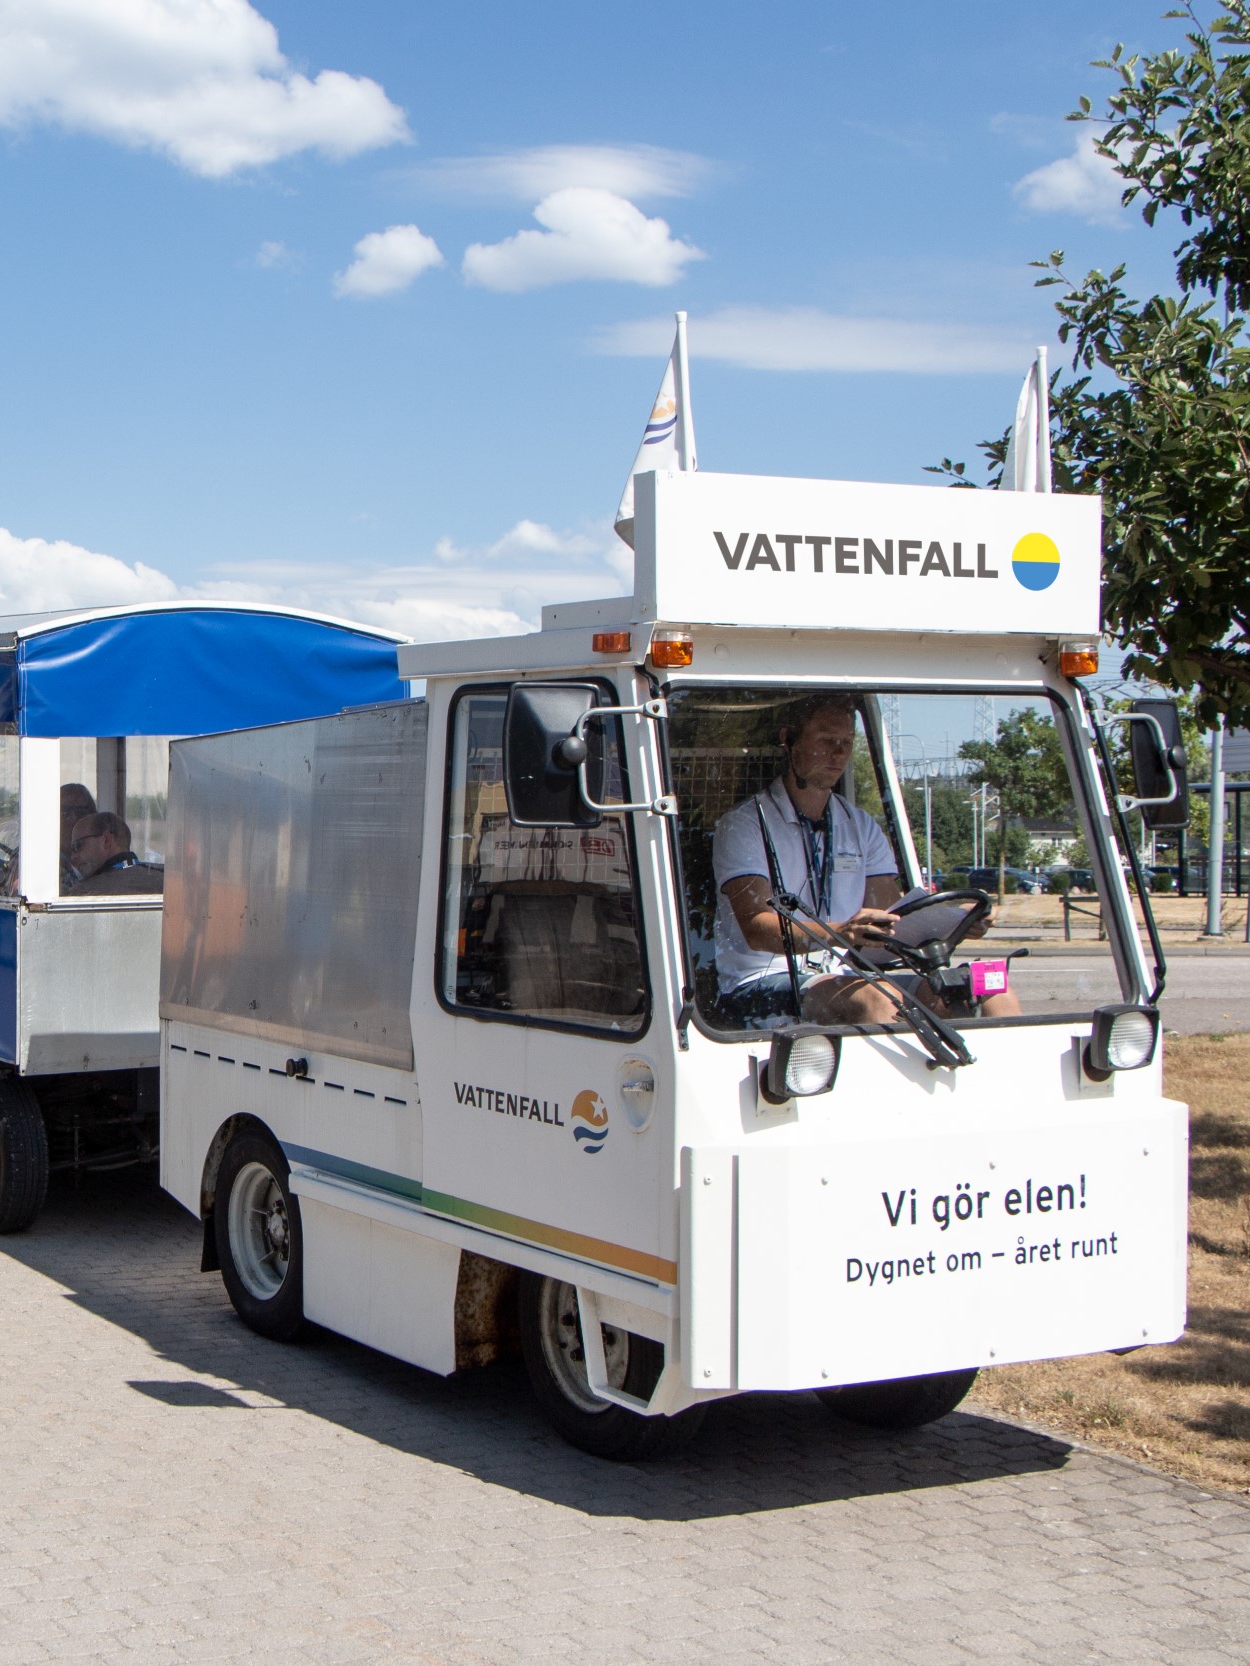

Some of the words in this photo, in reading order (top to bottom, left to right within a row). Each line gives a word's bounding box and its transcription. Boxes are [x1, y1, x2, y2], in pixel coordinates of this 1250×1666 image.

[713, 531, 999, 579] VATTENFALL
[453, 1081, 565, 1128] VATTENFALL
[881, 1188, 917, 1227] Vi
[932, 1182, 991, 1232] gör
[1004, 1174, 1087, 1216] elen!
[846, 1250, 936, 1287] Dygnet
[946, 1250, 982, 1272] om
[1015, 1236, 1062, 1265] året
[1071, 1231, 1118, 1259] runt
